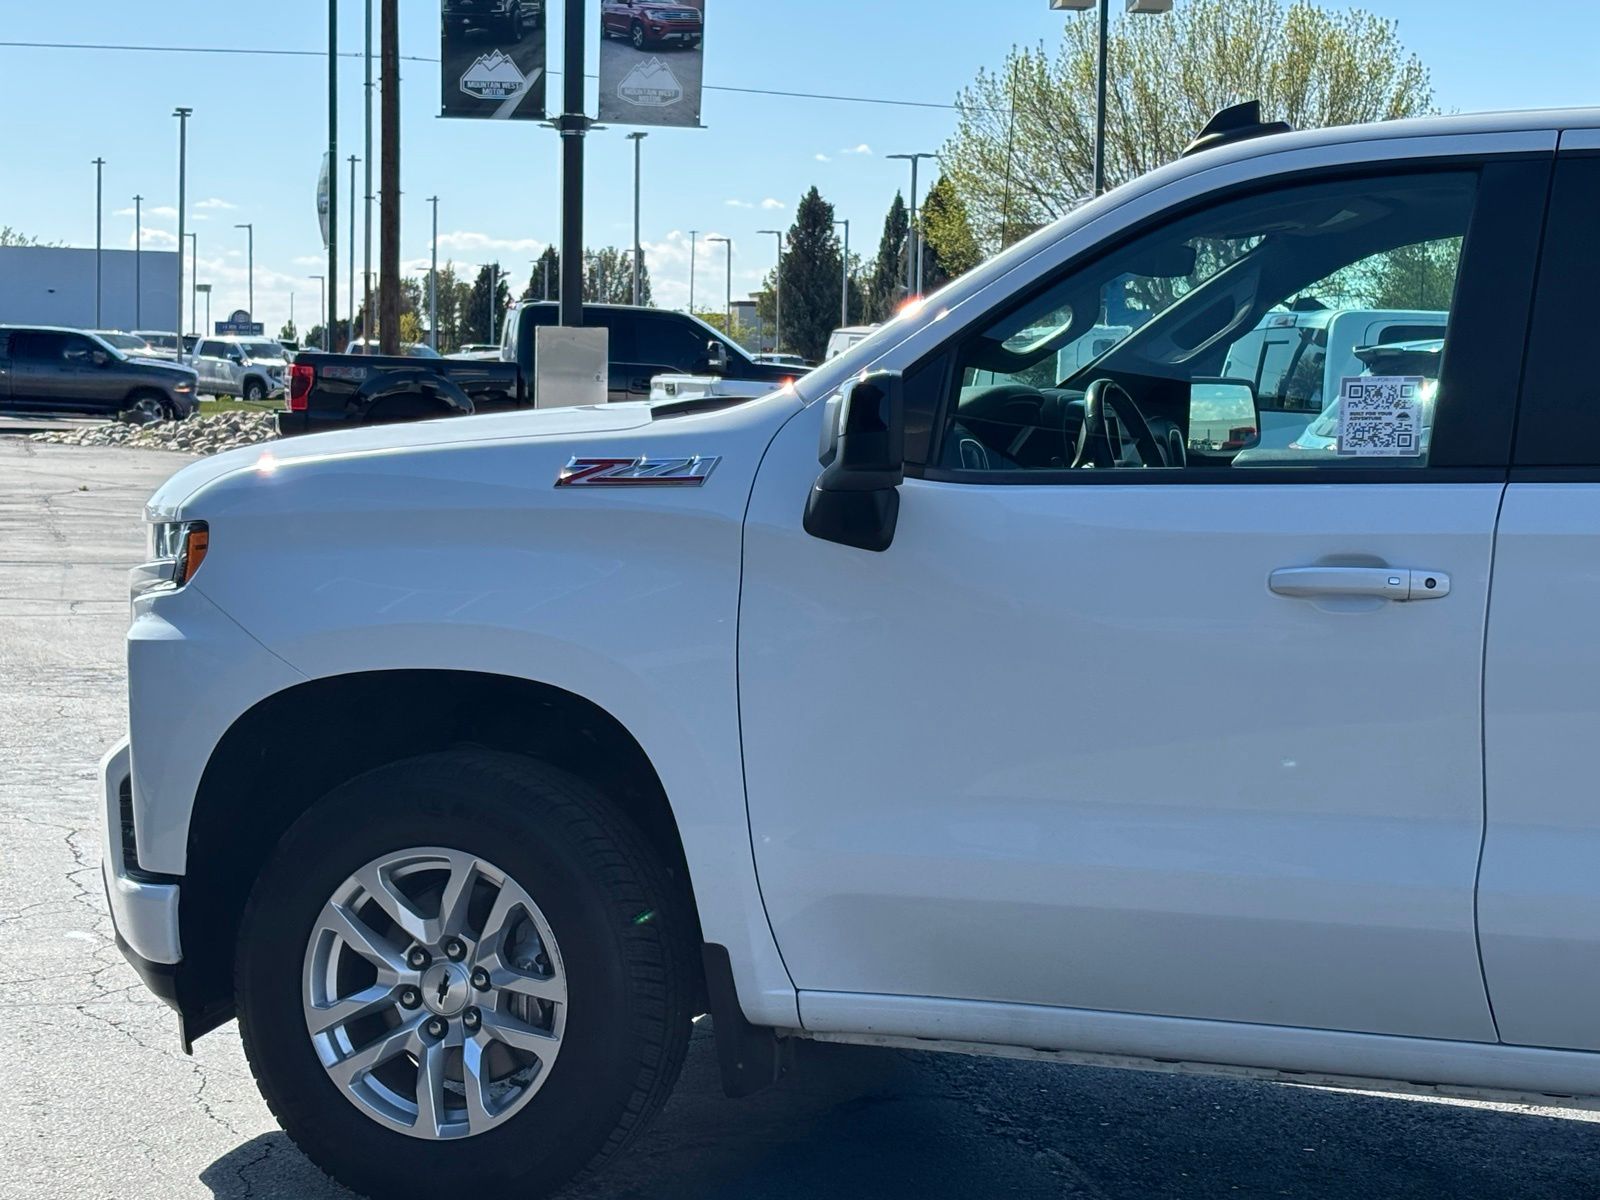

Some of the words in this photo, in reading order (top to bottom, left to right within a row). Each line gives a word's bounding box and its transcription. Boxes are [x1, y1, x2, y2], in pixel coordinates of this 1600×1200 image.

[467, 81, 501, 89] MOUNTAIN
[502, 82, 519, 90] WEST
[482, 88, 506, 96] MOTOR
[554, 456, 722, 488] Z71
